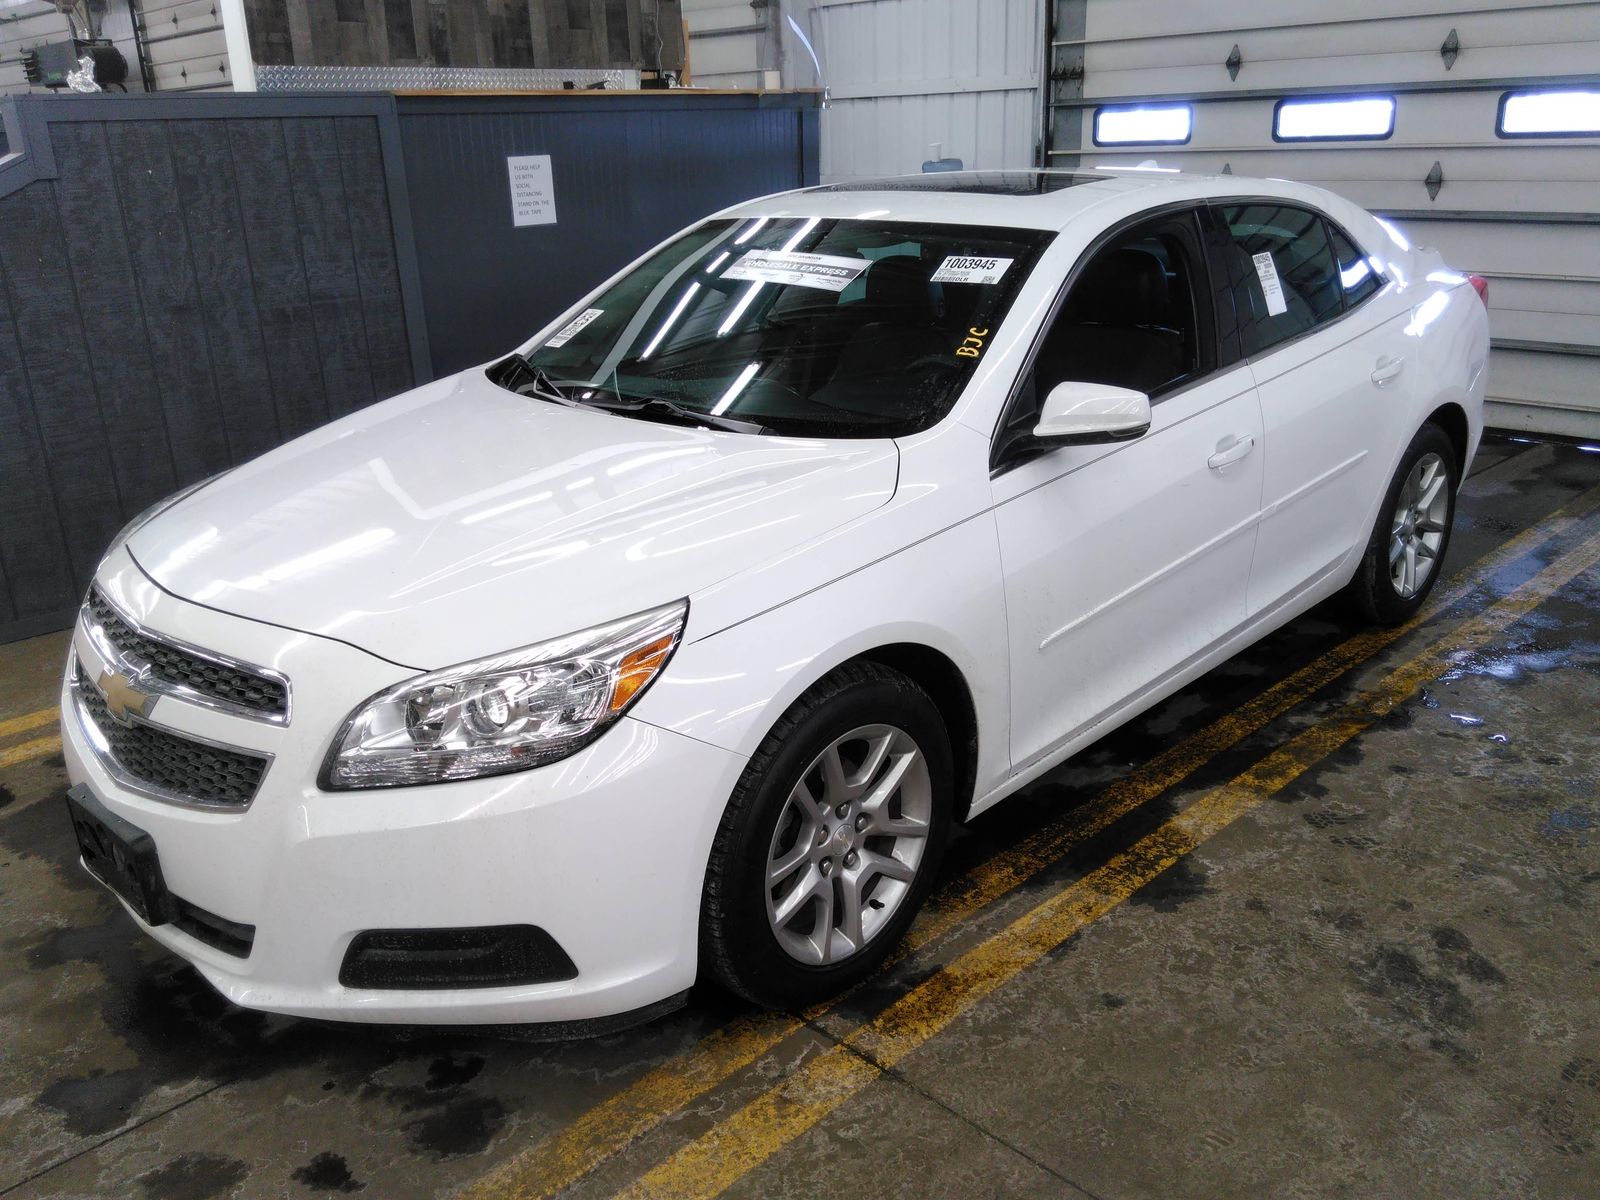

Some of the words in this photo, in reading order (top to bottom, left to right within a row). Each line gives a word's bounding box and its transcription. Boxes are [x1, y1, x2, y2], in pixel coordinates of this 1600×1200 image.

[800, 264, 849, 276] EXPRESS
[944, 258, 998, 270] 1003945
[956, 327, 989, 358] BJC
